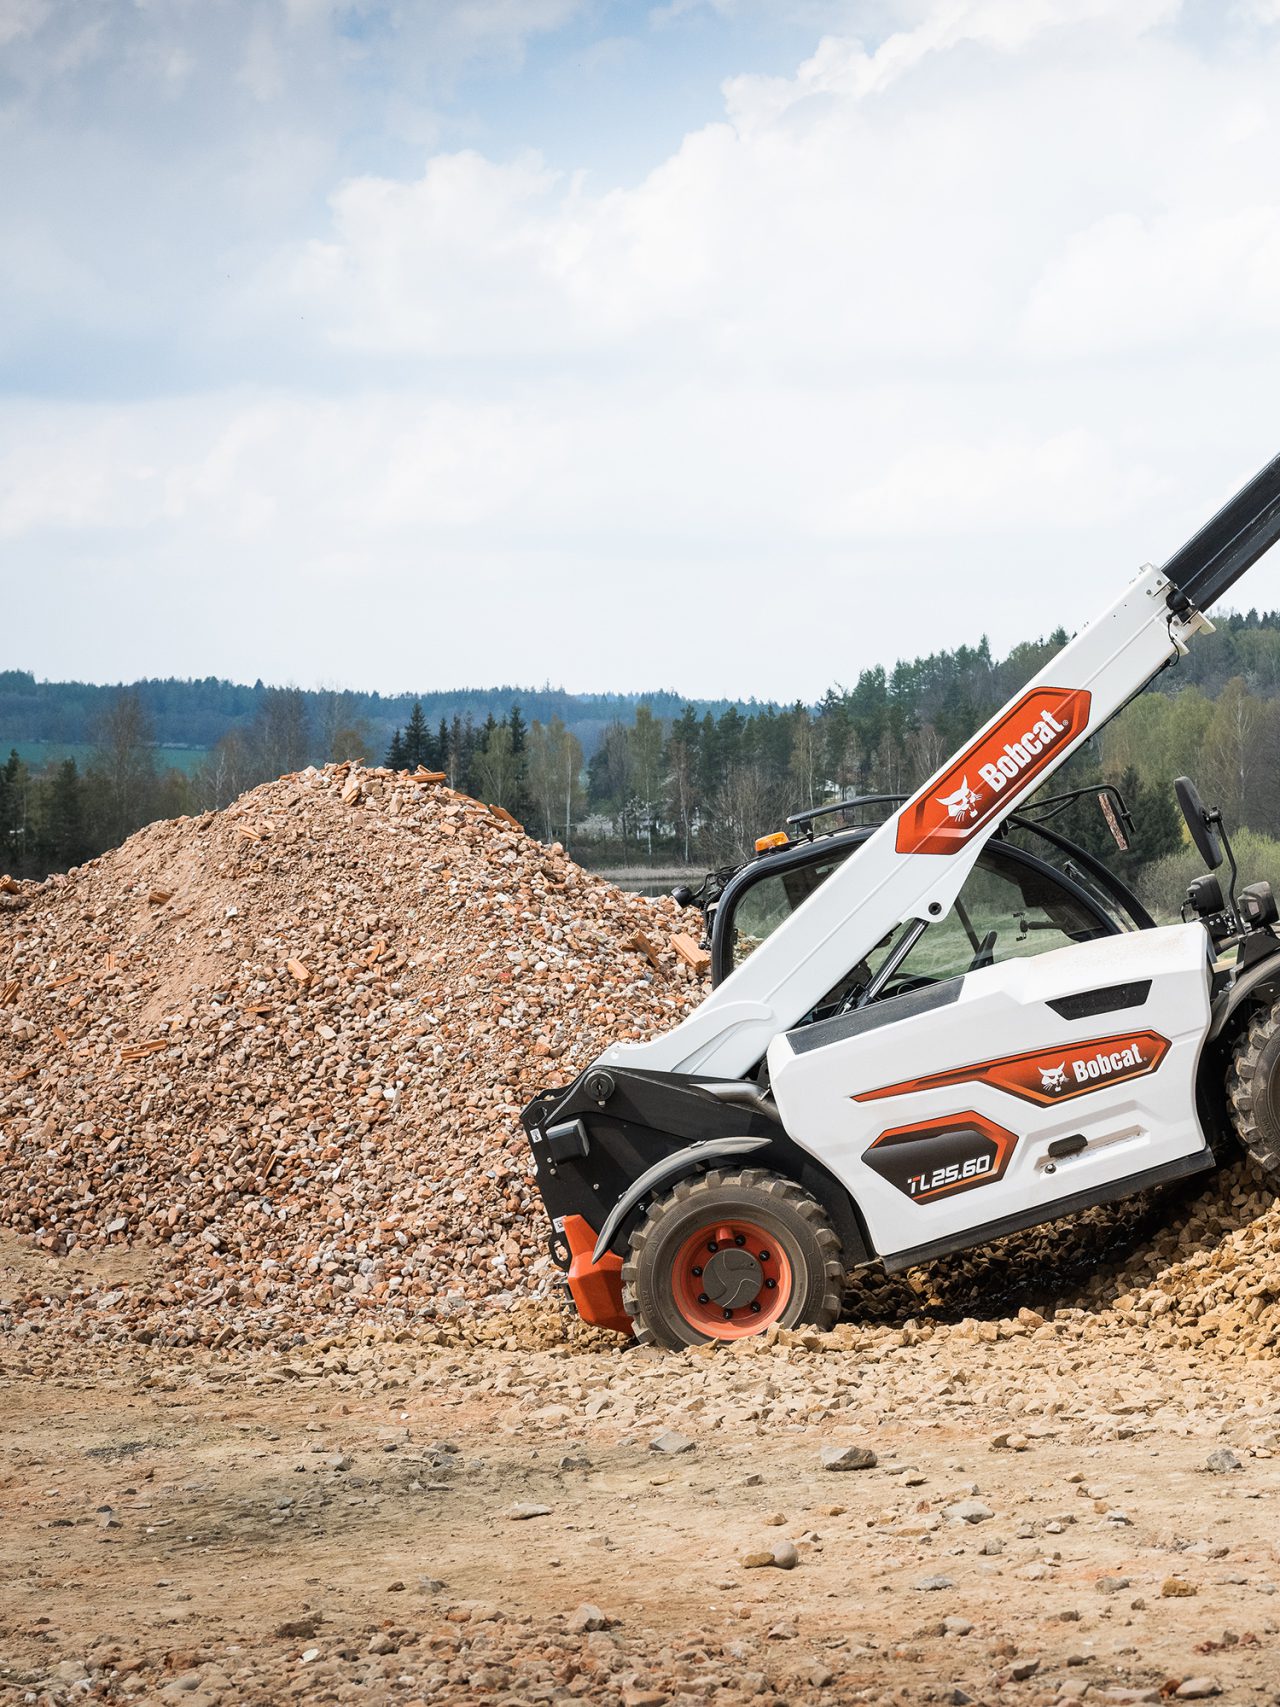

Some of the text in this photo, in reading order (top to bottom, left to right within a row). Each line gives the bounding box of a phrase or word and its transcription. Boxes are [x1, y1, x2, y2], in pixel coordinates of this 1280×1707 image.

[978, 709, 1065, 793] Bobcat
[1071, 1043, 1143, 1083] Bobcat
[907, 1154, 991, 1194] TL25.60
